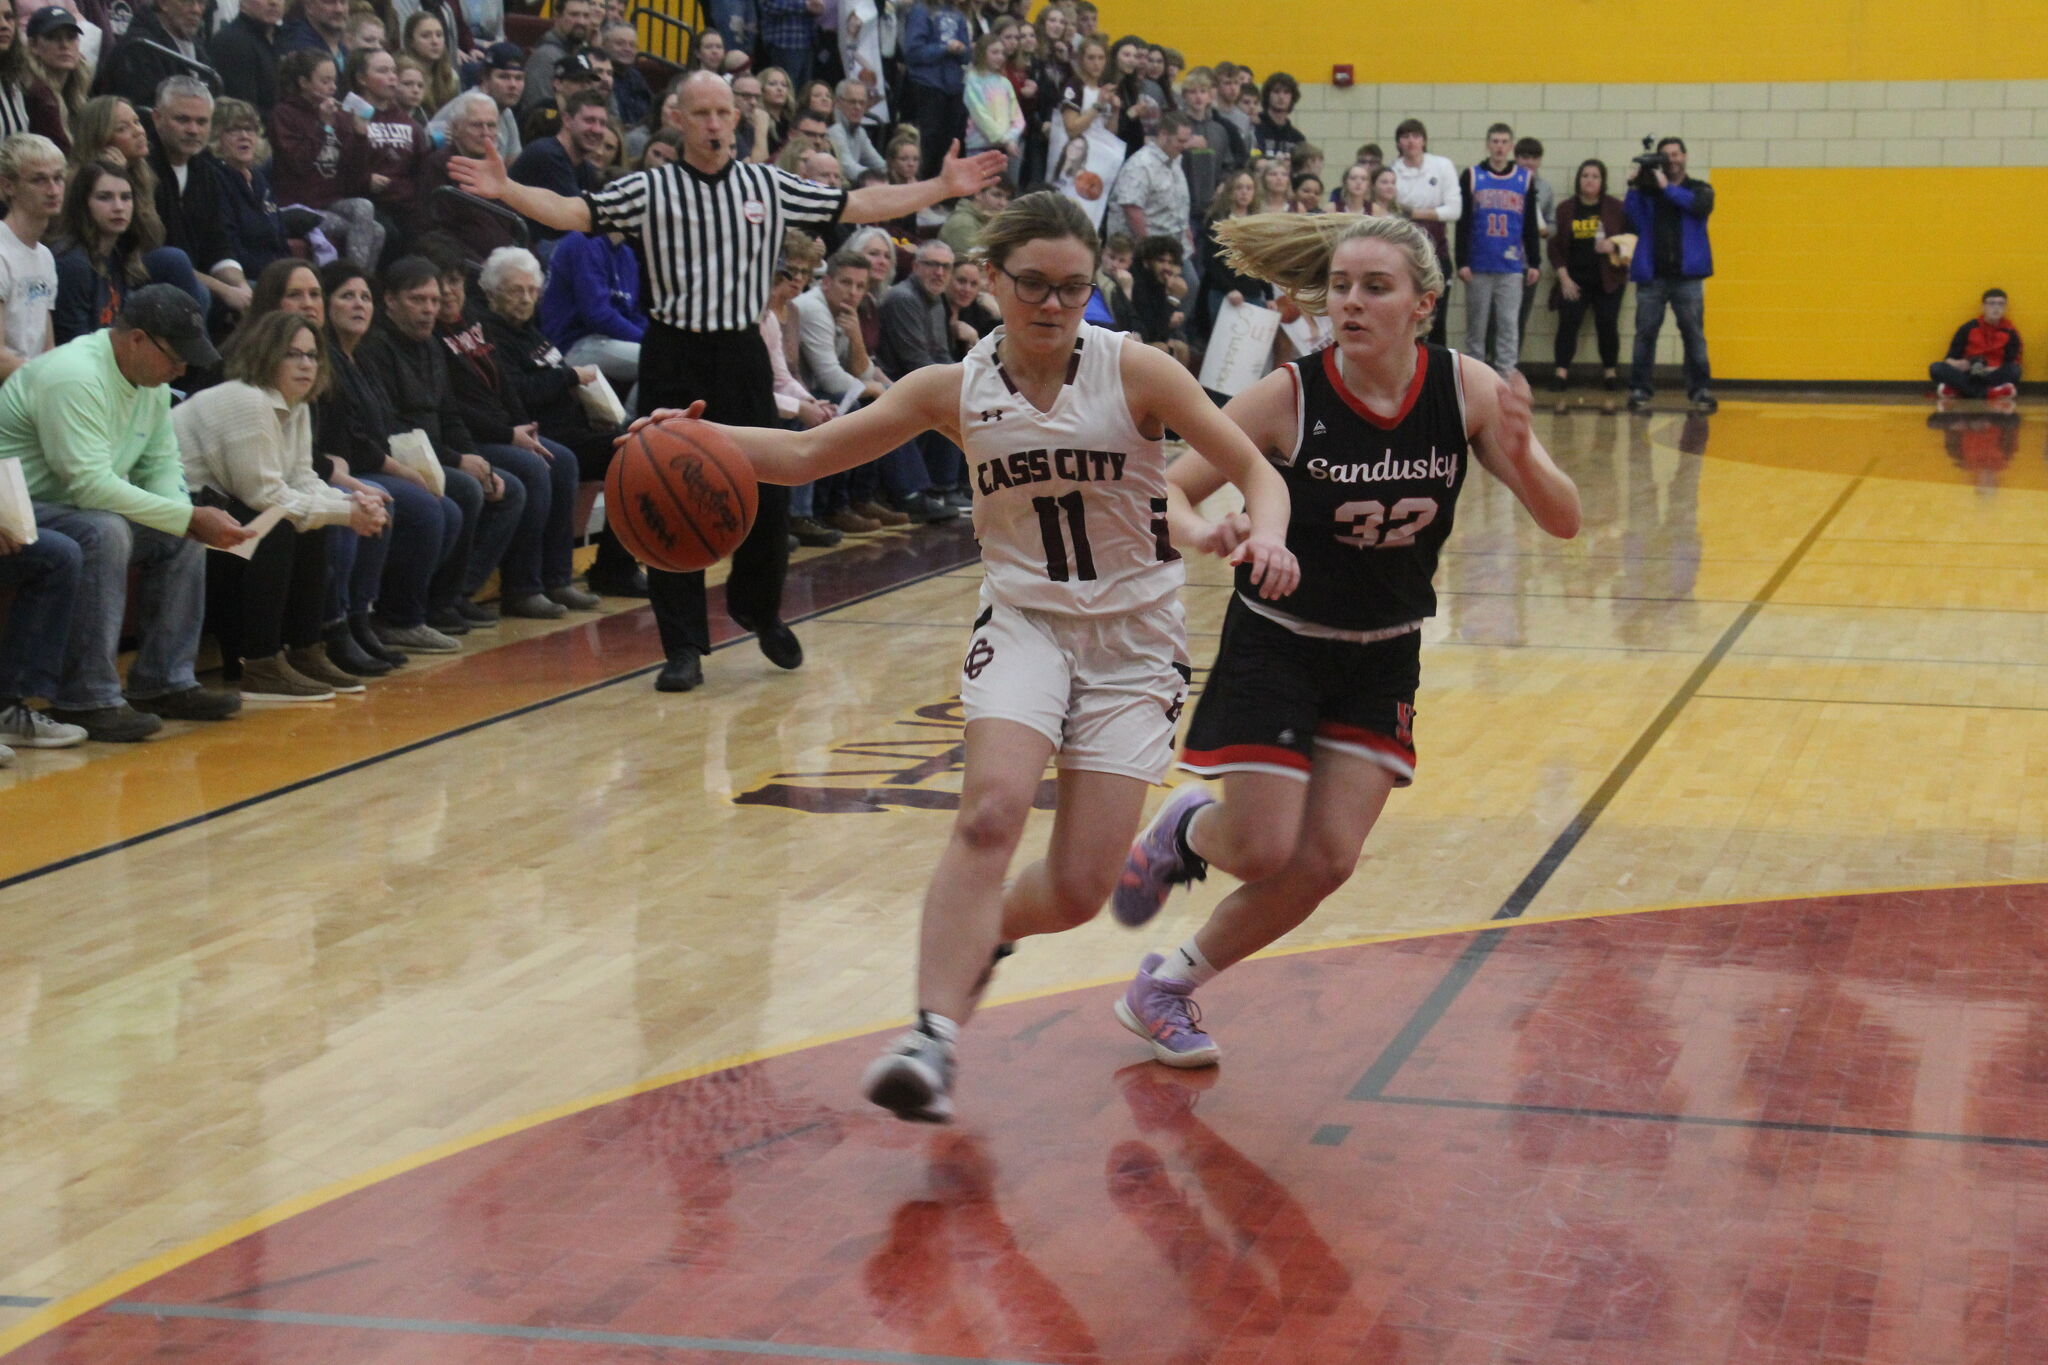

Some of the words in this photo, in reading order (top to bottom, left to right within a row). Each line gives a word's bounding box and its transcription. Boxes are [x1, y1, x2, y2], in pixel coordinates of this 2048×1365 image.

[1487, 213, 1508, 237] 11
[977, 449, 1052, 496] CASS
[1054, 448, 1127, 482] CITY
[1306, 445, 1458, 488] Sandusky
[1031, 490, 1098, 582] 11
[1334, 497, 1439, 549] 32
